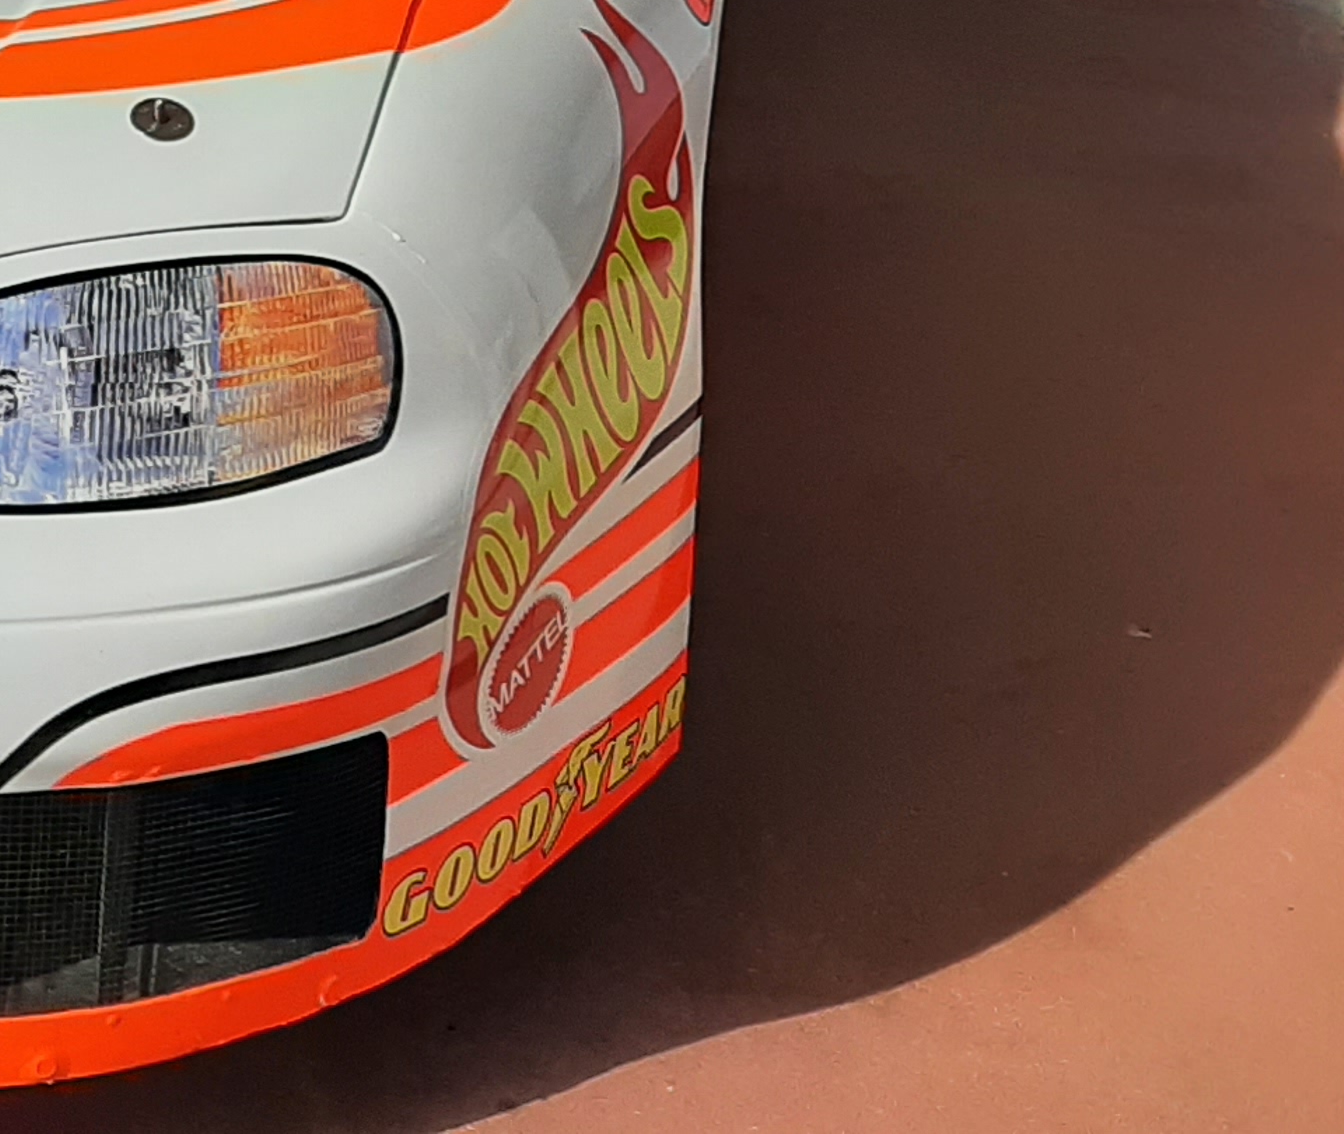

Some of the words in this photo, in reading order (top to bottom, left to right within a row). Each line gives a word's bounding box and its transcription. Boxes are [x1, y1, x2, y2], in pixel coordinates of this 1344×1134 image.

[455, 499, 534, 670] HOT
[486, 610, 569, 717] MATTEL
[382, 674, 688, 938] GOODYEAR
